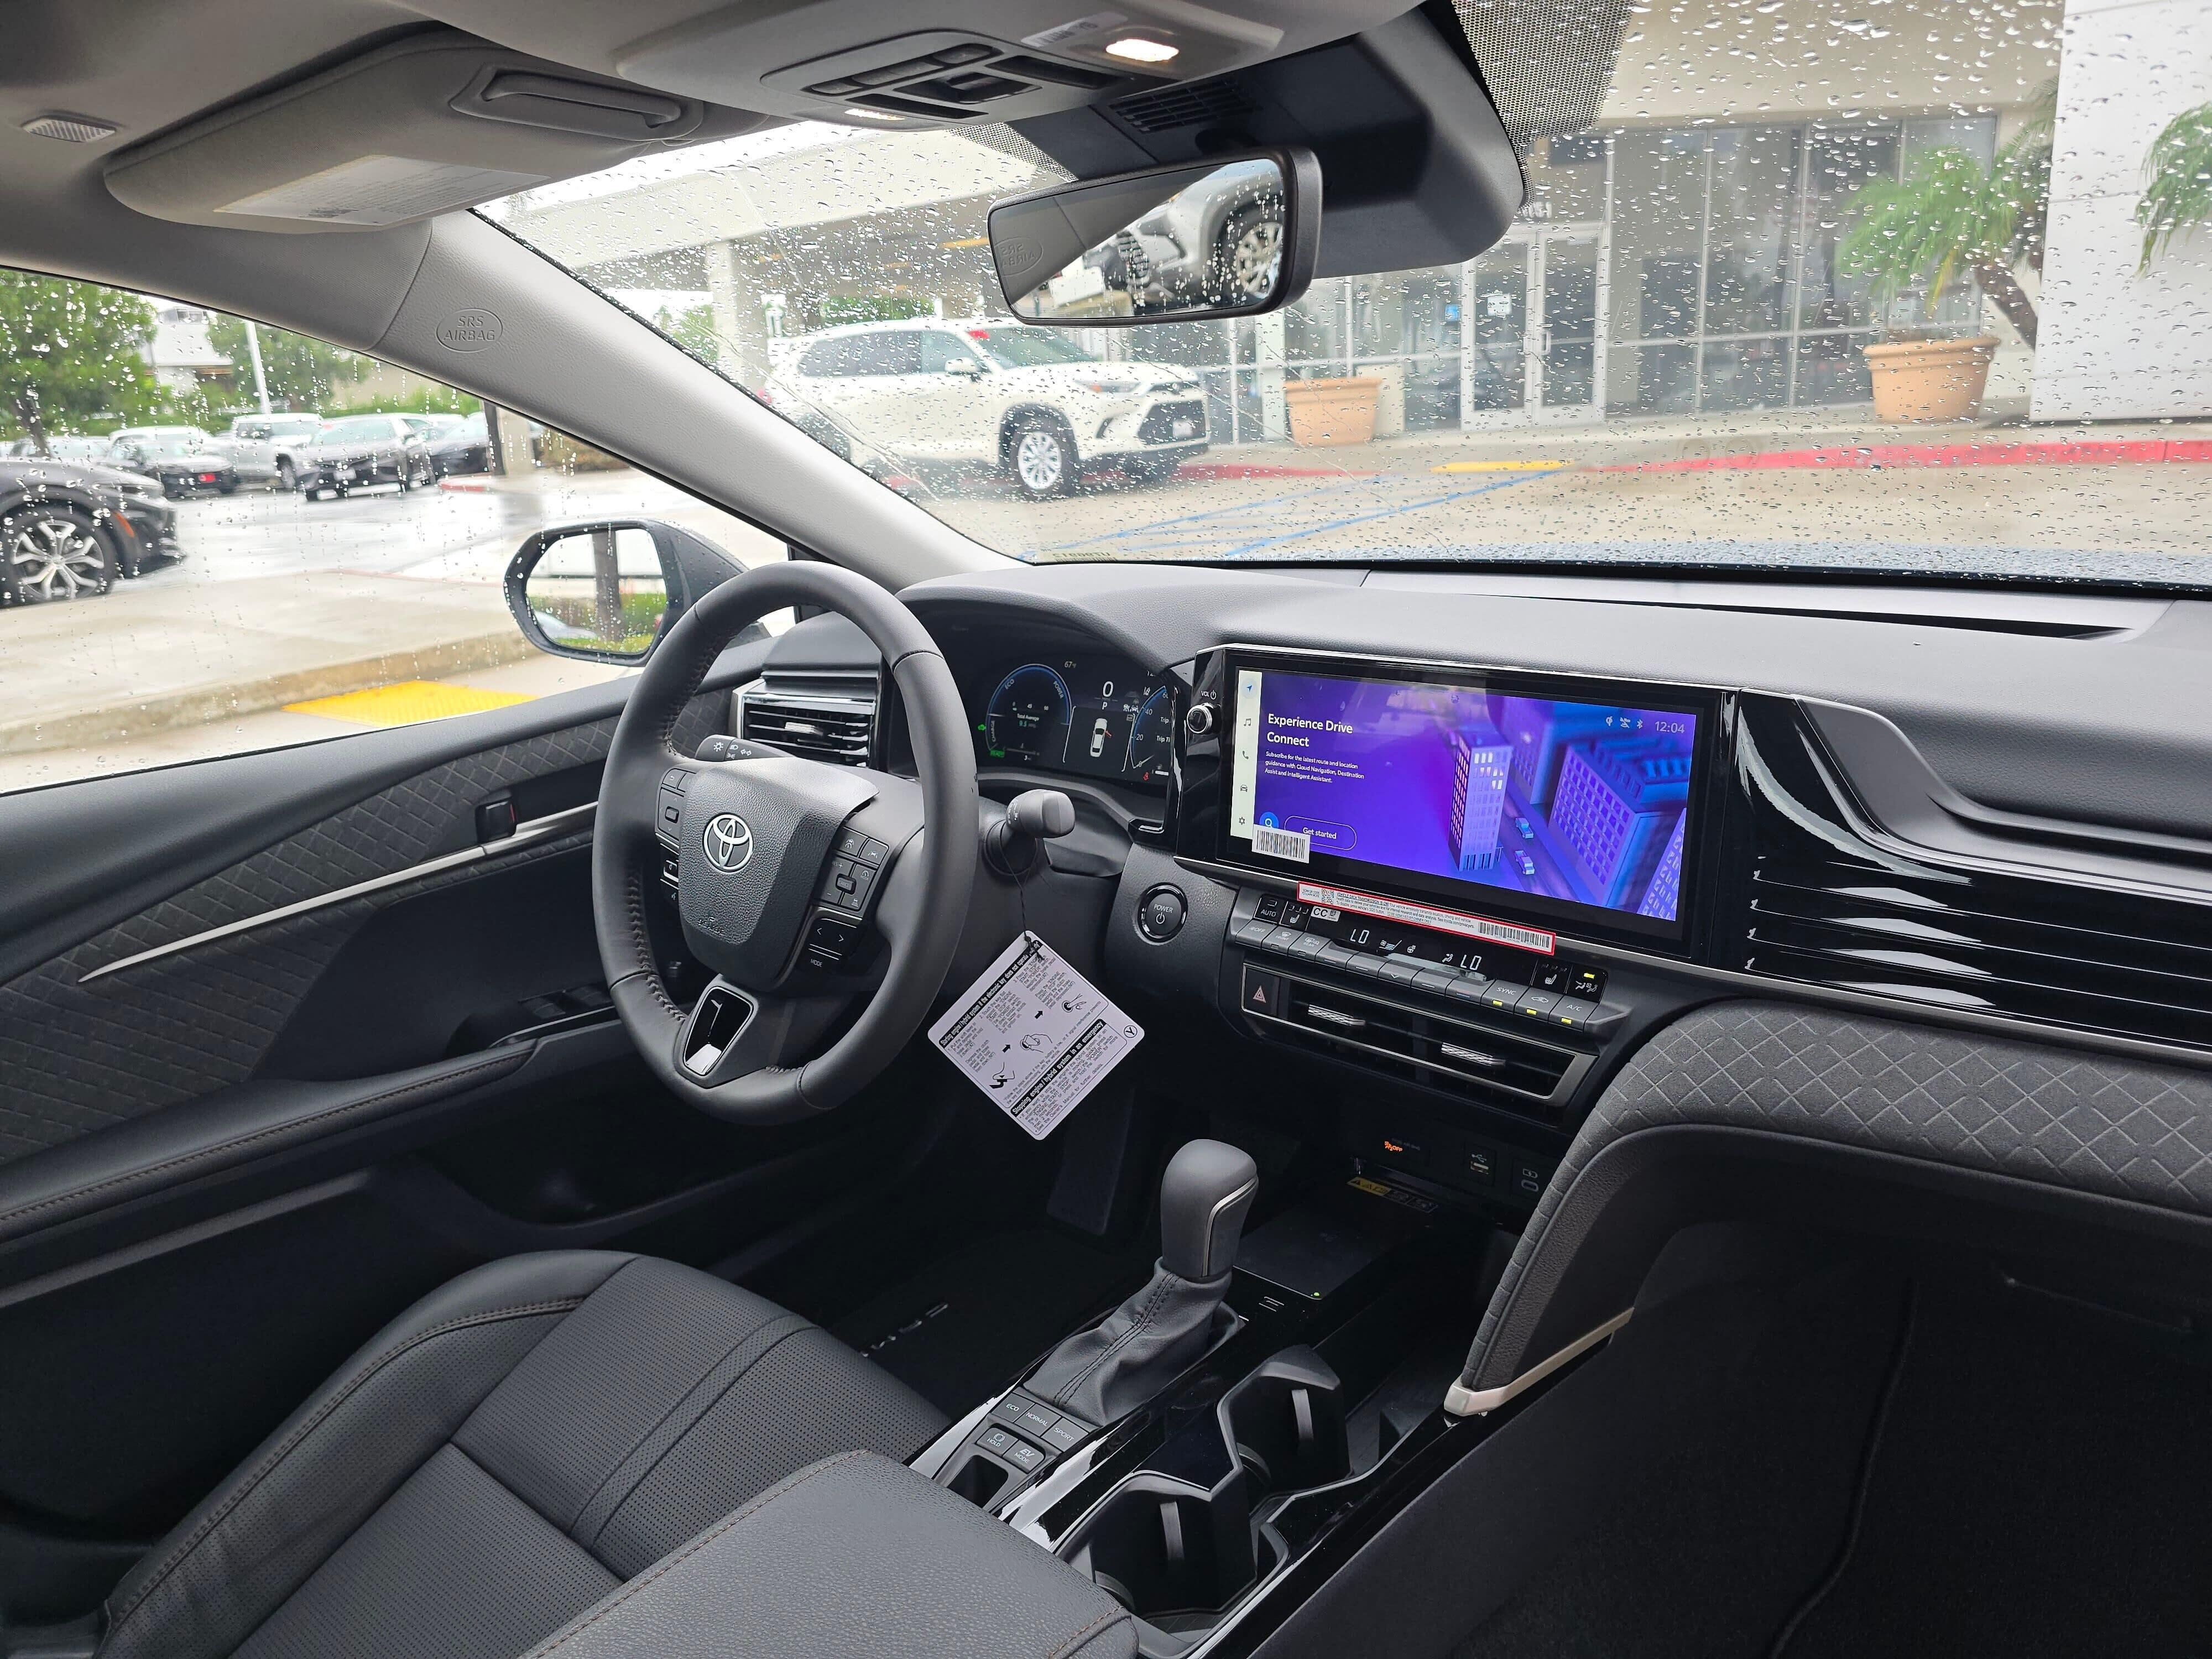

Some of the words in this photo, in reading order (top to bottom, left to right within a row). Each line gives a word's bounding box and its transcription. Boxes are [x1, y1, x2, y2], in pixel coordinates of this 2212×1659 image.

[457, 316, 484, 328] SRS
[443, 330, 495, 342] AIRBAG
[1103, 681, 1114, 697] 0
[1102, 702, 1108, 710] P
[1268, 713, 1323, 730] Experience
[1326, 720, 1353, 734] Drive
[1655, 721, 1685, 734] 12:04
[1156, 735, 1165, 743] Trip
[1267, 732, 1310, 747] Connect
[1266, 751, 1287, 759] Subscribe
[1339, 761, 1358, 769] location
[1287, 771, 1310, 780] Intelligent
[1337, 770, 1364, 779] Destination
[1303, 827, 1314, 836] Get
[1315, 830, 1337, 839] started
[1154, 904, 1173, 913] POWER
[1260, 909, 1276, 917] AUTO
[1313, 907, 1328, 917] CC
[1350, 928, 1370, 944] LO
[810, 958, 823, 968] MODE
[1460, 954, 1481, 971] LO
[1003, 968, 1014, 979] does
[1010, 963, 1019, 971] not
[1496, 987, 1516, 995] SYNC
[1125, 1027, 1136, 1036] Y
[1012, 1095, 1031, 1115] Stopping
[1029, 1082, 1044, 1098] engine
[1043, 1067, 1058, 1083] hybrid
[1055, 1053, 1072, 1070] system
[1081, 1020, 1104, 1044] emergency
[1026, 1412, 1047, 1427] NORMAL
[1053, 1428, 1074, 1441] SPORT
[987, 1437, 1001, 1447] HOLD
[1014, 1452, 1030, 1464] MODE
[1019, 1448, 1035, 1458] EV
